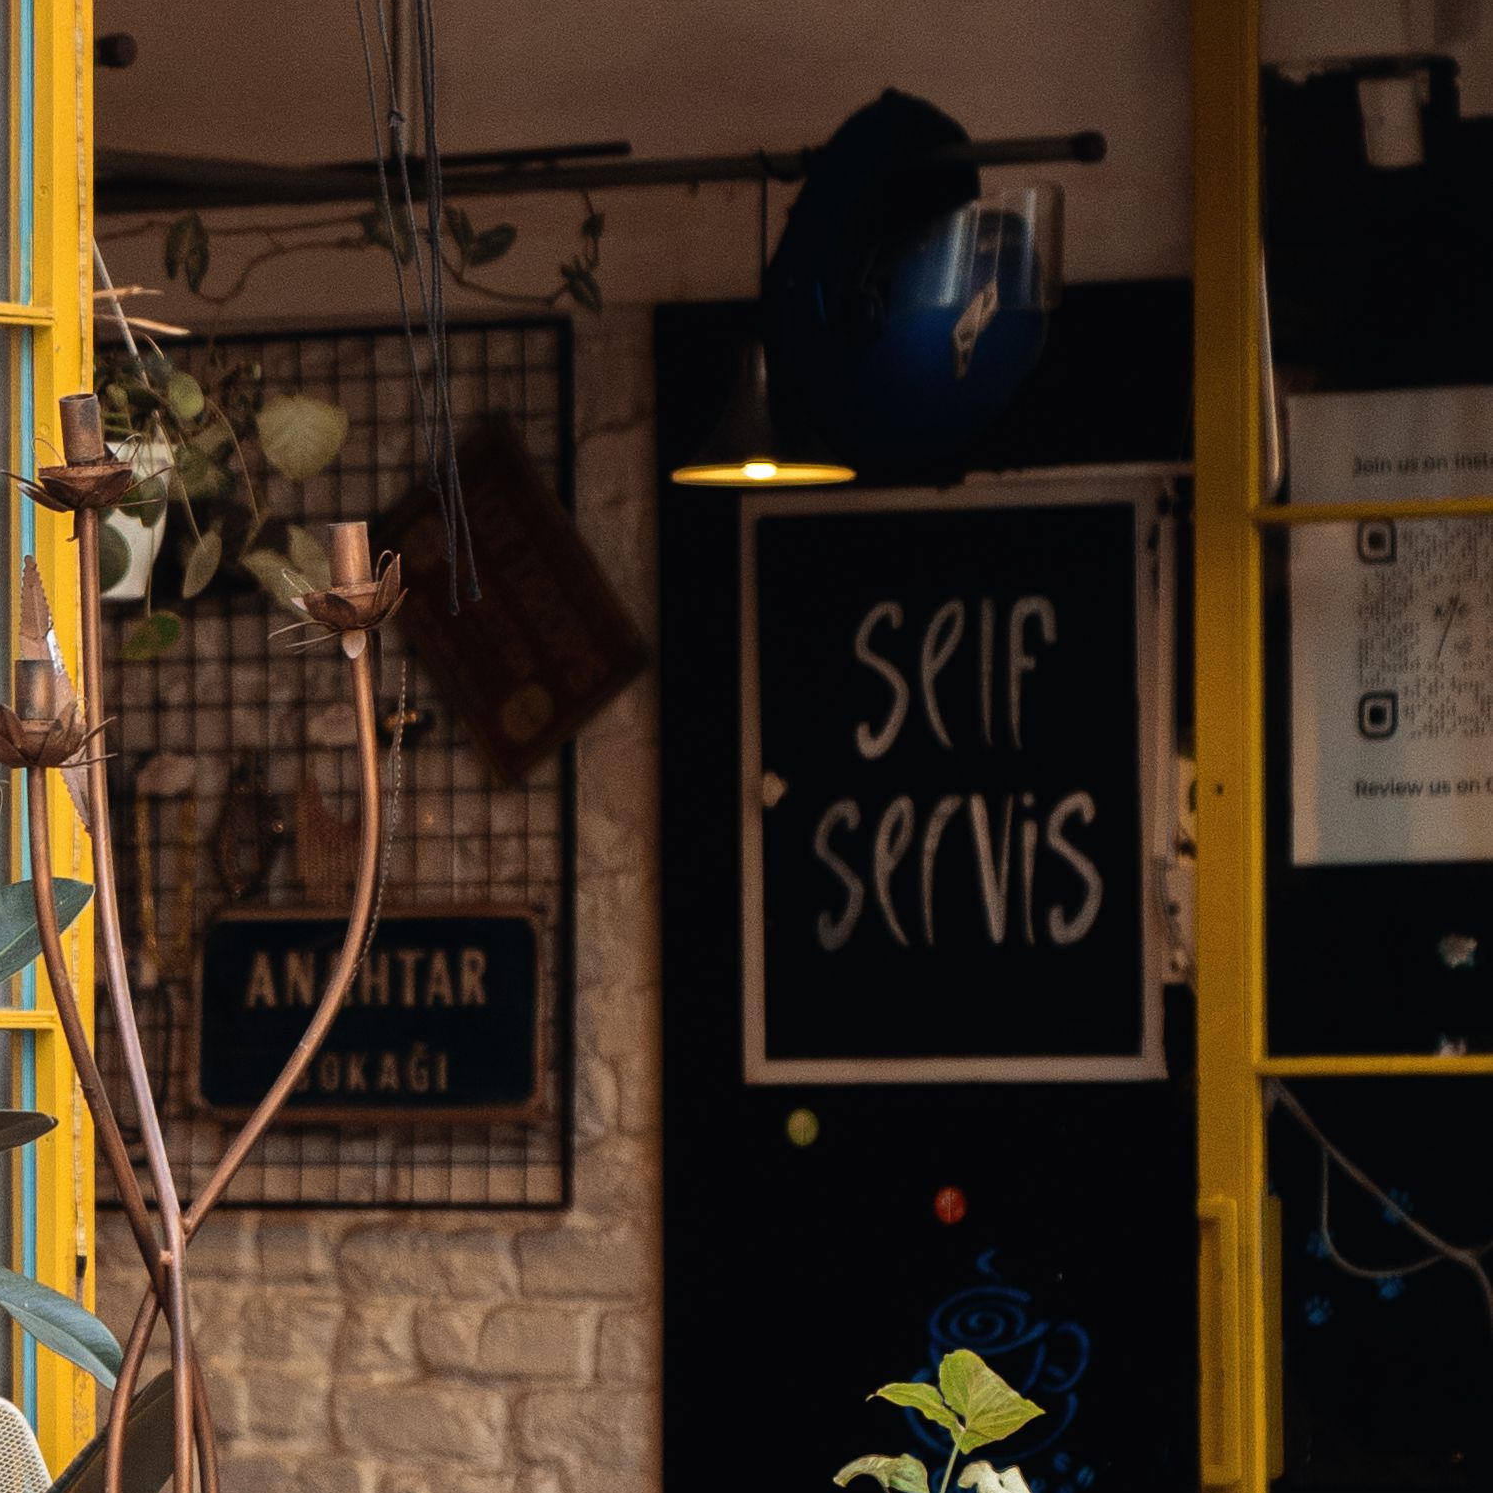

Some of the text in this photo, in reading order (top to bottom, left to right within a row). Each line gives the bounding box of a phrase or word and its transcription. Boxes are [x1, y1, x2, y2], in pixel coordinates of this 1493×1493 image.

[1354, 457, 1392, 477] Join
[1398, 459, 1419, 473] us
[1423, 457, 1448, 471] on
[1354, 779, 1423, 796] Review
[1429, 780, 1451, 795] us
[1457, 779, 1480, 794] on
[296, 1041, 450, 1093] OKAĞI
